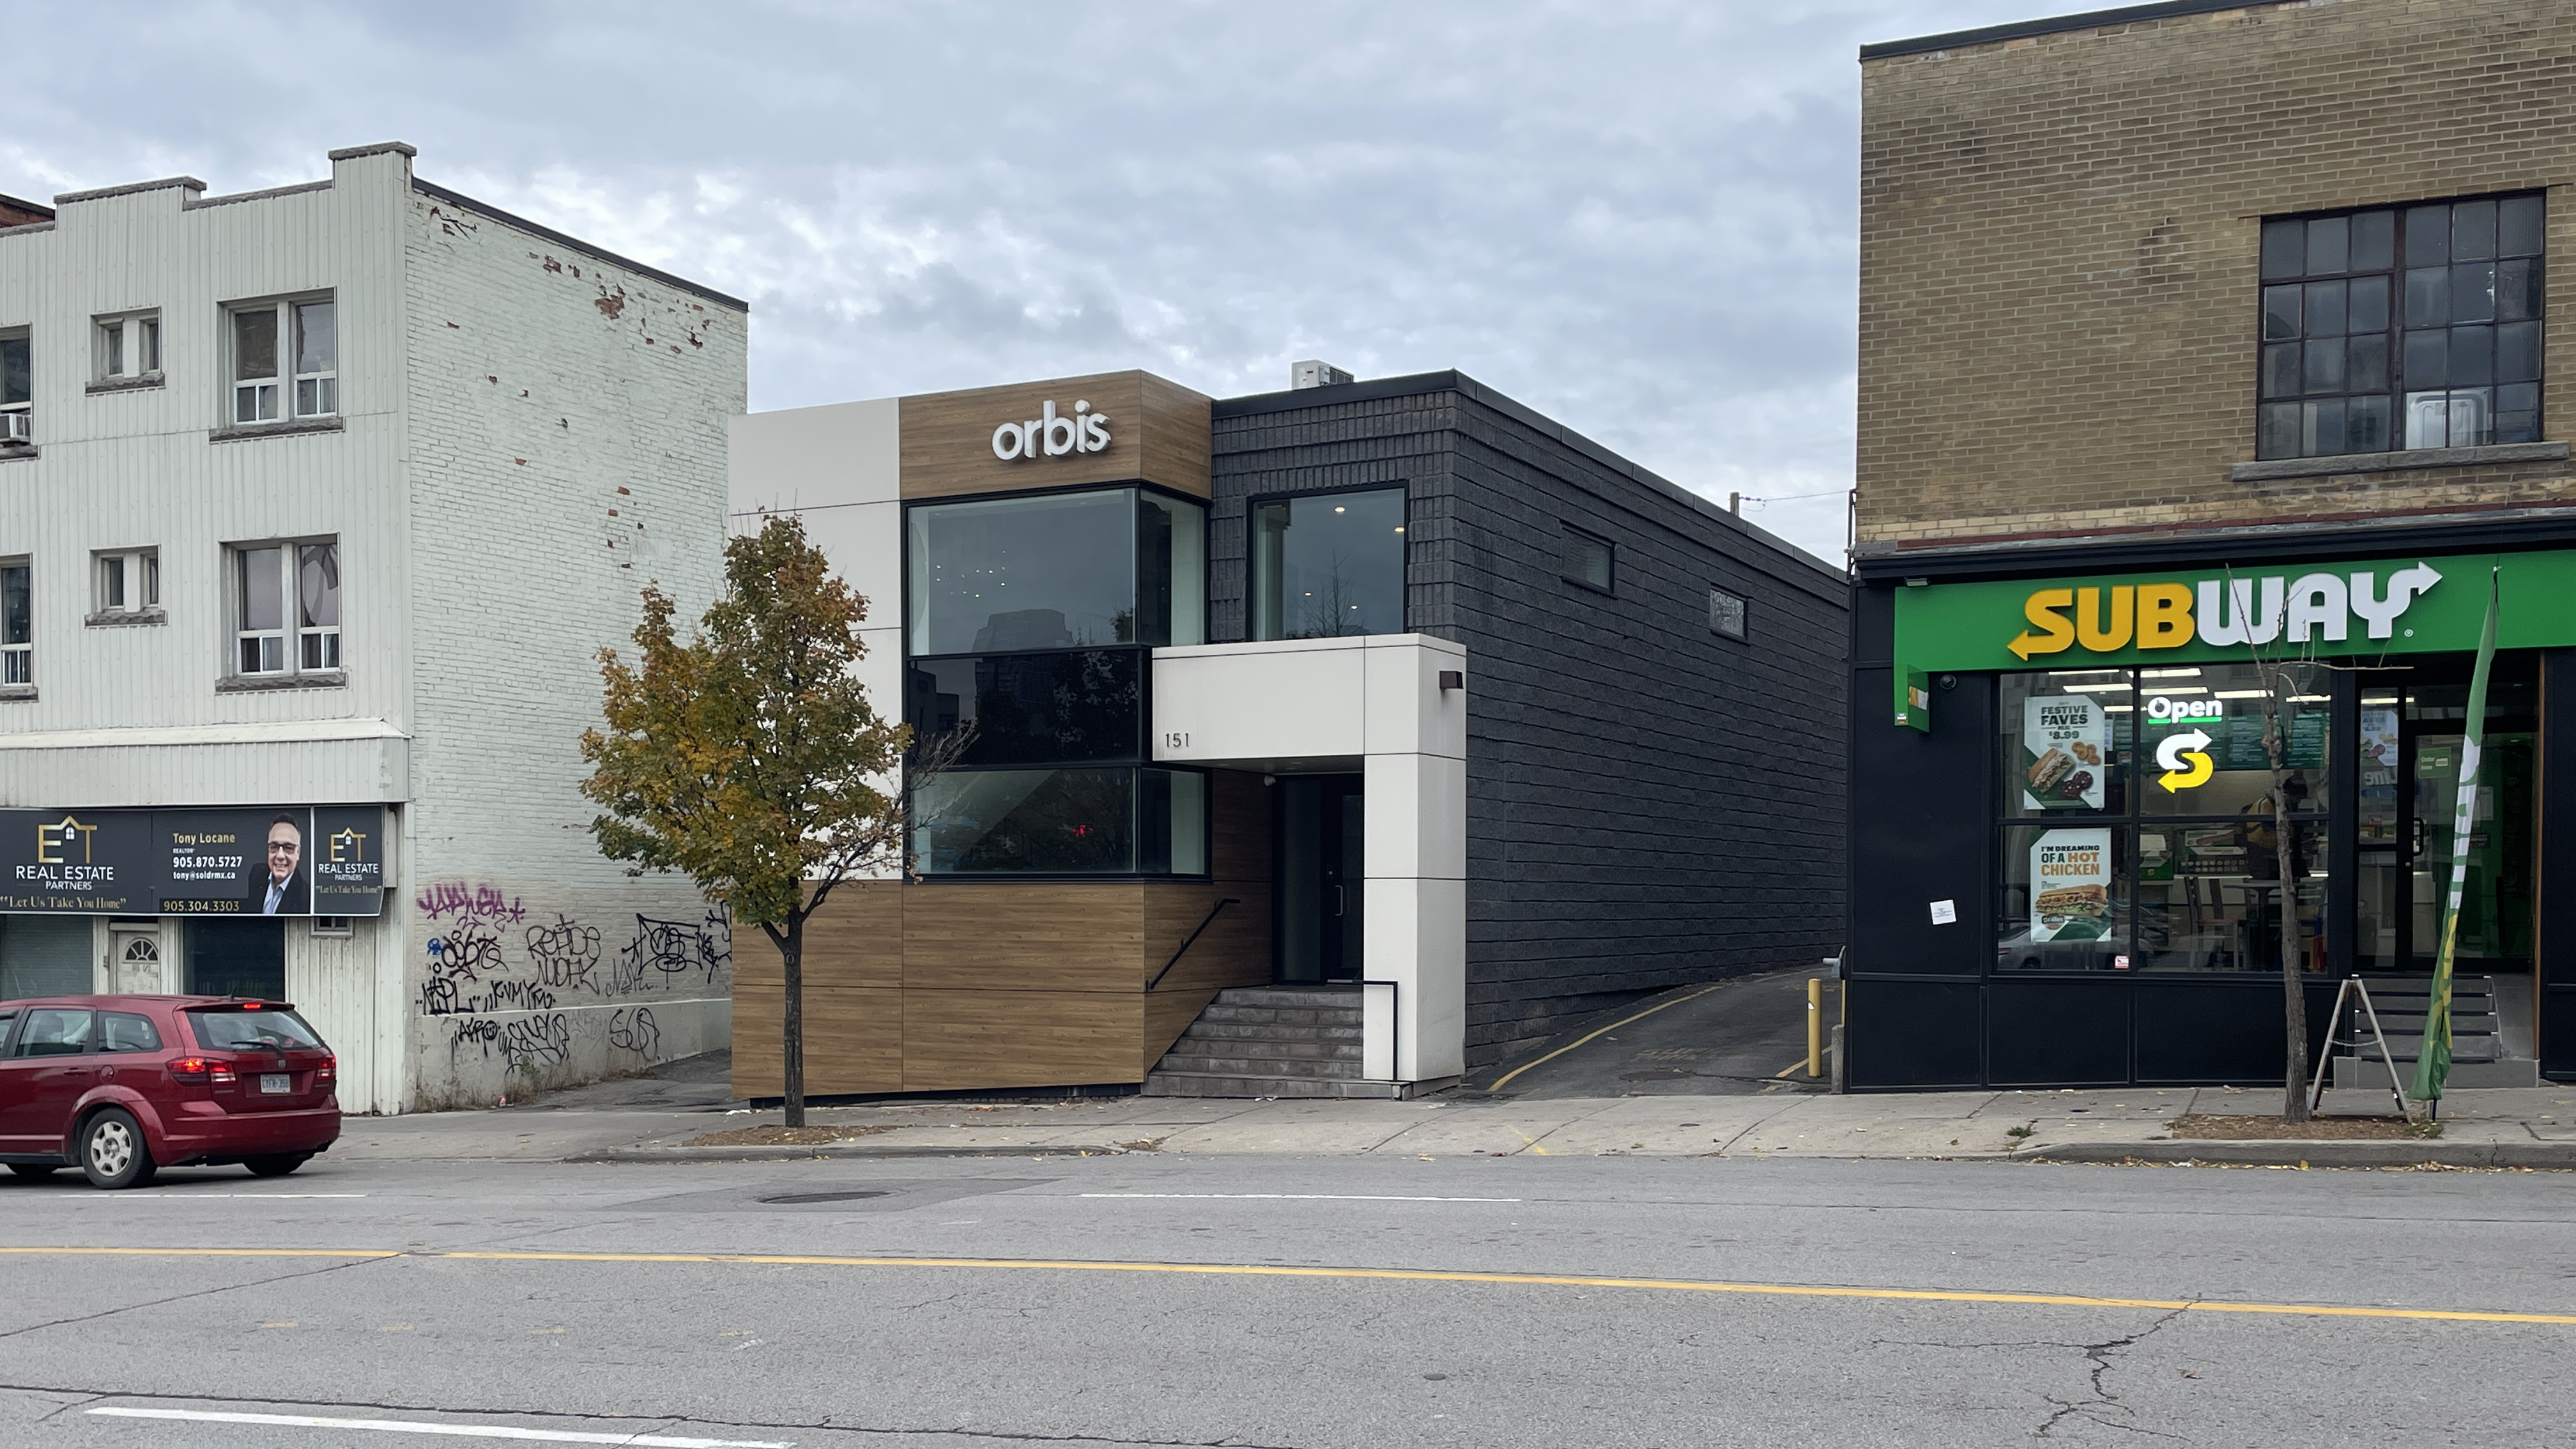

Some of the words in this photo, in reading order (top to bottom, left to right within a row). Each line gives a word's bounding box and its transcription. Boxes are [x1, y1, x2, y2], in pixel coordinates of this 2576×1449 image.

[992, 399, 1112, 460] orbis
[2007, 562, 2442, 661] SUBWAY
[2041, 705, 2089, 714] FESTIVE
[2147, 696, 2223, 723] Open
[2041, 714, 2089, 726] FAVES
[1165, 733, 1190, 747] 151
[173, 832, 196, 845] Tony
[199, 832, 236, 843] Locane
[172, 856, 242, 868] 905.870.5727
[2041, 853, 2055, 863] OF
[2057, 853, 2065, 862] A
[2067, 852, 2100, 862] HOT
[16, 866, 58, 879] REAL
[65, 866, 114, 880] ESTATE
[318, 864, 342, 873] REAL
[345, 864, 379, 873] ESTATE
[2041, 863, 2100, 876] CHICKEN
[172, 871, 236, 880] tony@soldrmx.ca
[45, 881, 92, 890] PARTNERS
[31, 896, 45, 908] Us
[48, 896, 74, 908] Take
[77, 896, 94, 908] You
[164, 900, 240, 912] 905.304.3303
